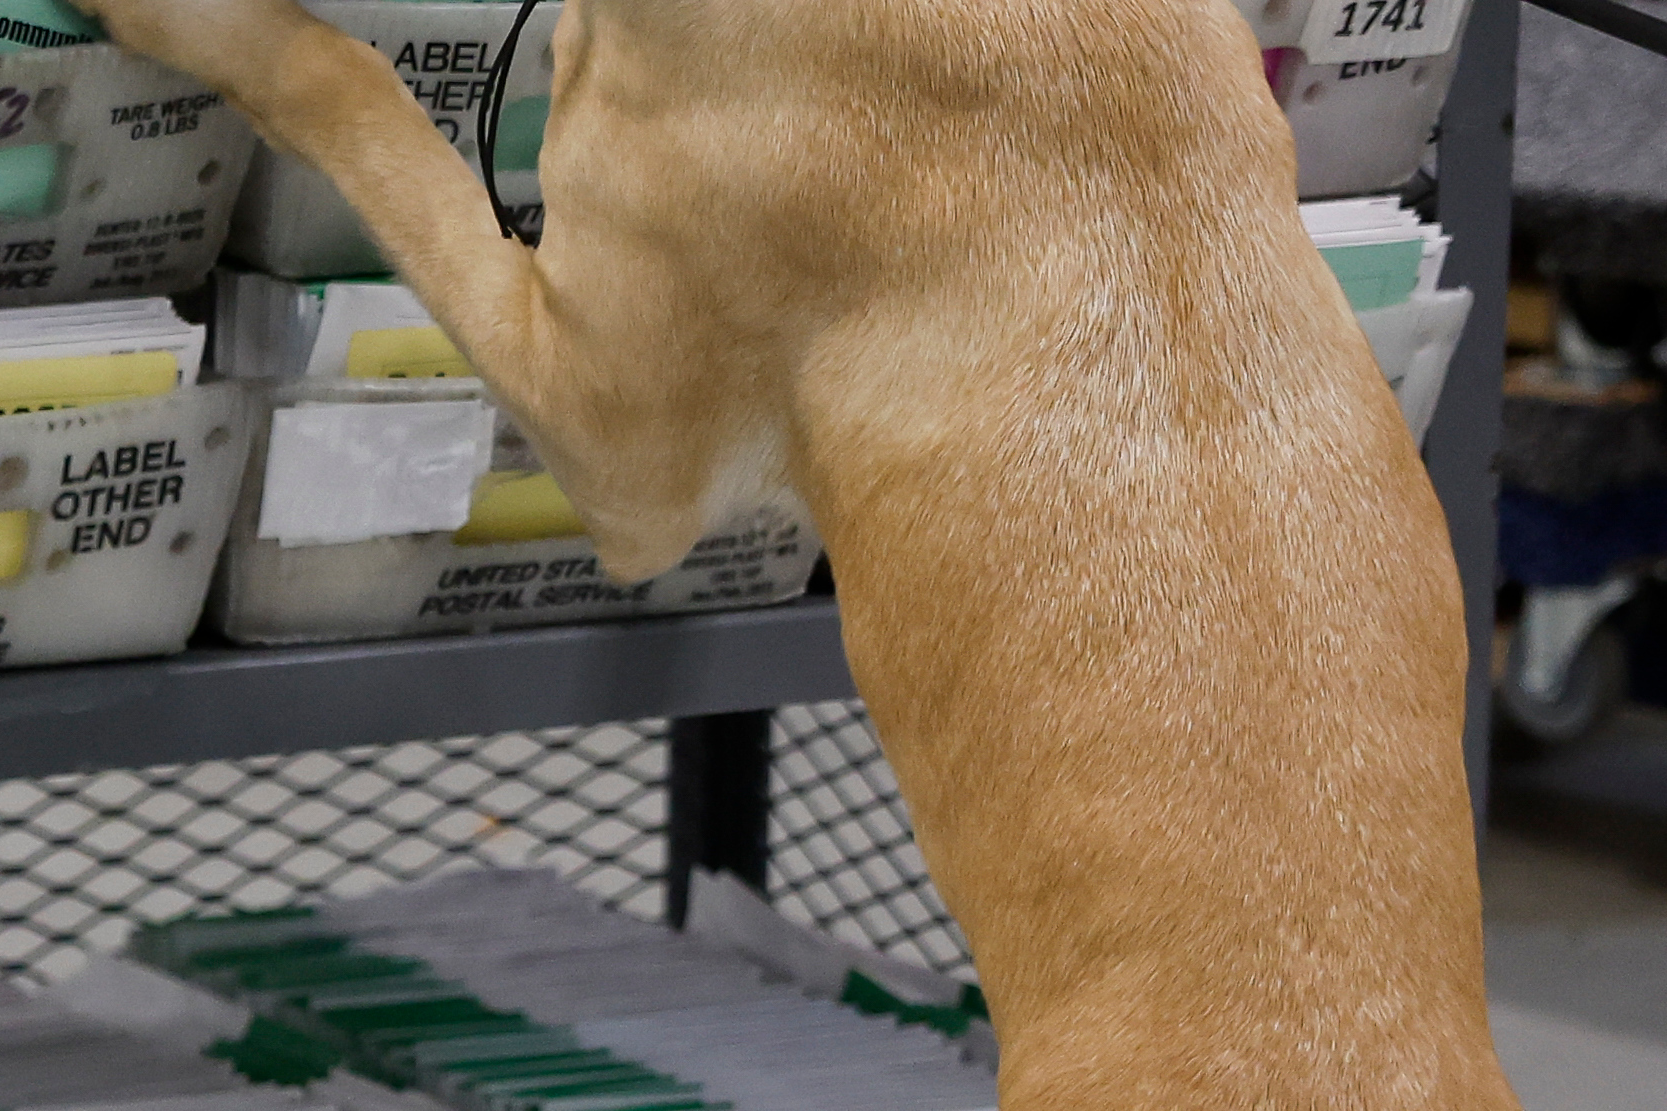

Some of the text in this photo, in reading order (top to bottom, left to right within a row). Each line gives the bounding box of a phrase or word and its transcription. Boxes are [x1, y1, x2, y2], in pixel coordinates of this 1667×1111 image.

[371, 40, 492, 73] ABEL
[110, 103, 155, 125] TARE
[164, 115, 200, 135] LBS
[60, 441, 187, 487] LABEL
[50, 476, 184, 522] OTHER
[70, 515, 156, 555] END
[438, 562, 541, 589] UNITED
[418, 589, 525, 617] POSTAL
